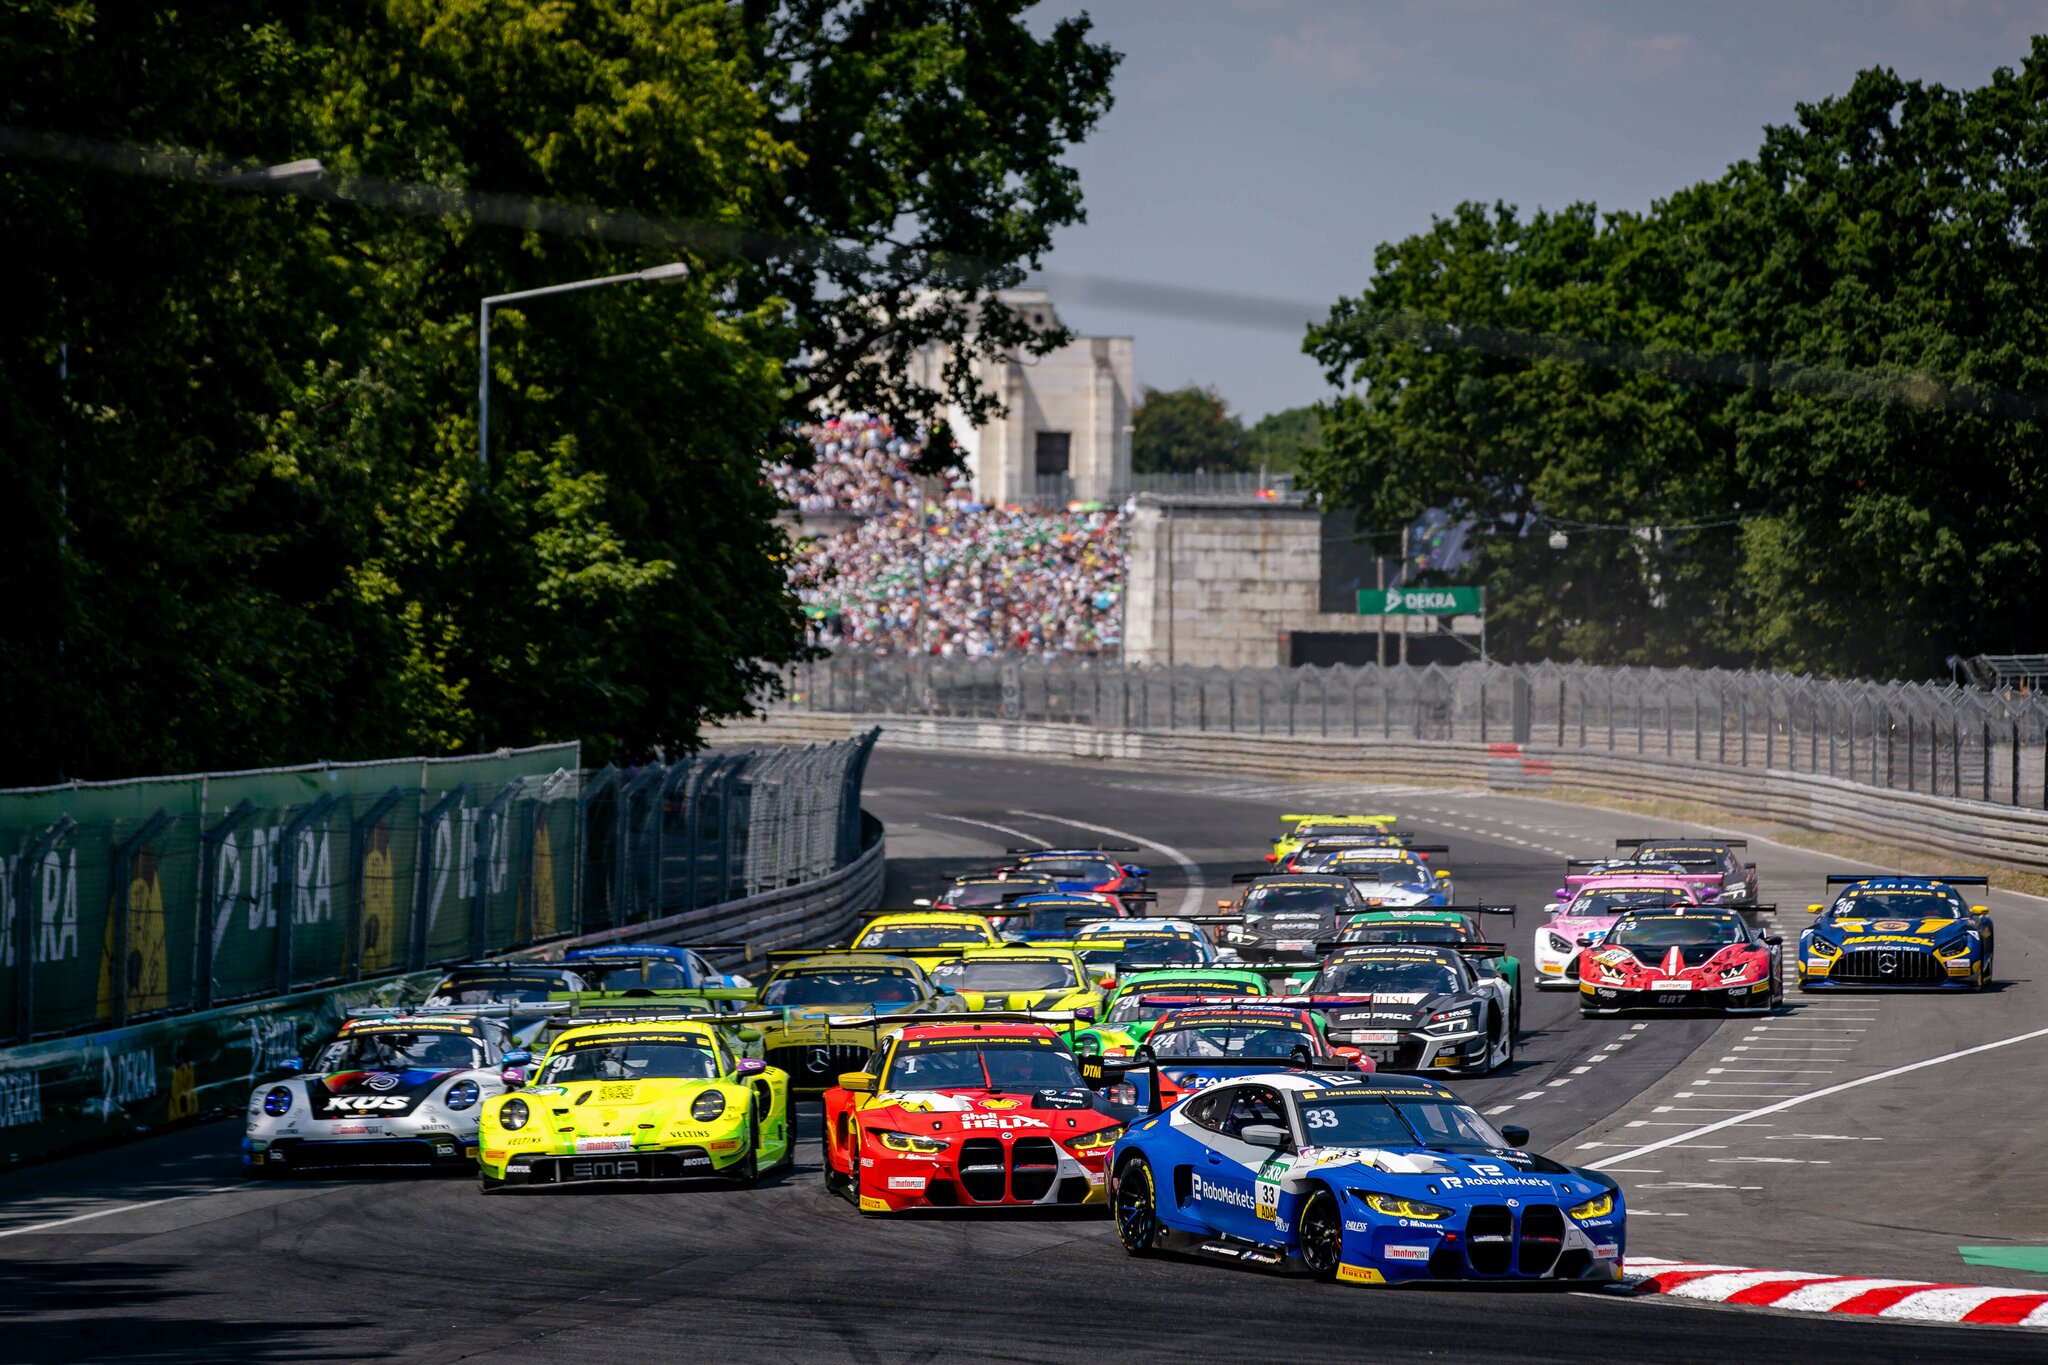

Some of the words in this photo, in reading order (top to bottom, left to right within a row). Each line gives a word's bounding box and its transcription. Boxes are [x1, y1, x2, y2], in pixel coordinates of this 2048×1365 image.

[1405, 592, 1457, 609] DEKRA
[249, 821, 332, 930] DERA
[1571, 899, 1592, 912] 84
[1834, 900, 1856, 915] 36
[1616, 921, 1637, 931] 63
[1842, 935, 1935, 947] MANNOL
[941, 966, 964, 976] 94
[1152, 1033, 1179, 1050] 24
[552, 1054, 577, 1074] 91
[904, 1058, 918, 1075] 1
[1083, 1064, 1102, 1078] DTM
[961, 1112, 998, 1120] Shell
[961, 1115, 1050, 1130] HELIX
[1305, 1109, 1339, 1129] 33
[670, 1130, 710, 1139] VELTINS
[507, 1137, 542, 1146] VELTINS
[683, 1156, 711, 1166] MOTUL
[505, 1165, 532, 1174] MOTUL
[573, 1160, 639, 1176] EMA
[1463, 1176, 1551, 1187] RoboMarkets
[1203, 1181, 1256, 1210] RoboMarkets
[1262, 1185, 1275, 1205] 33
[1393, 1249, 1429, 1259] motorsport
[1342, 1266, 1372, 1279] PIRELLI
